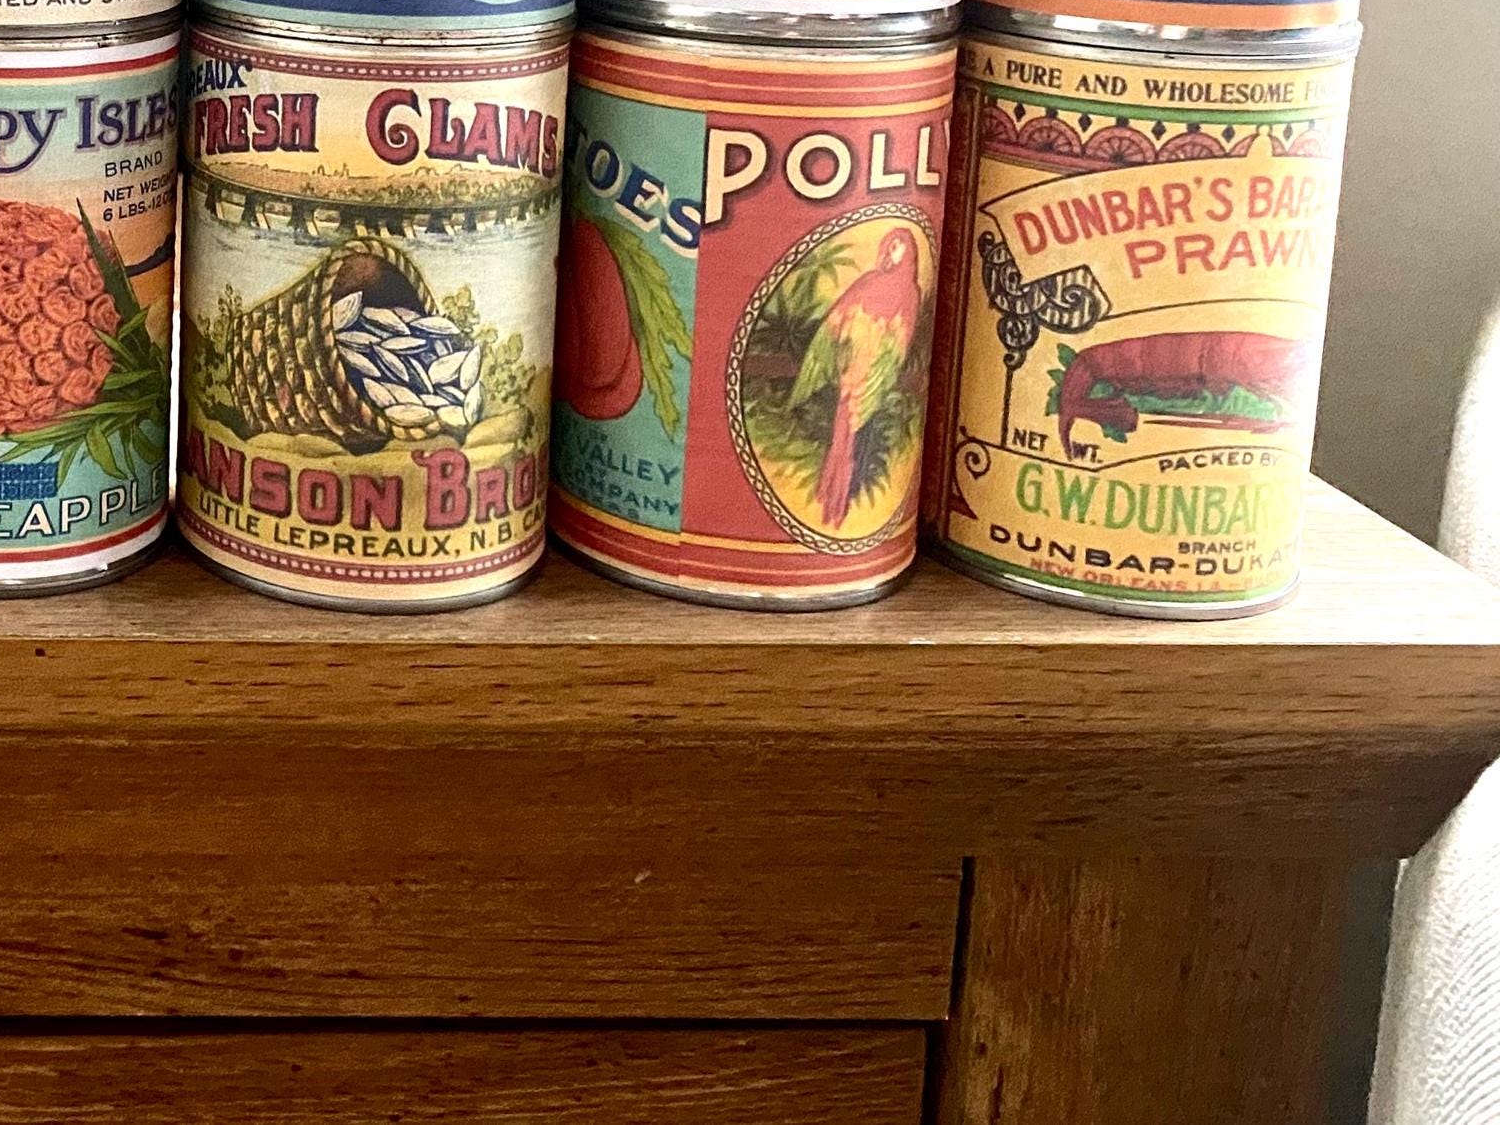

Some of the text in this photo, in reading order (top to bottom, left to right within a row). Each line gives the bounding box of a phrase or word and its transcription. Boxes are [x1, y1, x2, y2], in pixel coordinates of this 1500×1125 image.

[983, 57, 994, 76] A
[1006, 60, 1063, 89] PURE
[1075, 74, 1128, 97] AND
[1144, 78, 1295, 104] WHOLESOME
[194, 88, 560, 178] FRESH CLAMS
[105, 151, 163, 177] BRAND
[104, 185, 134, 203] NET
[103, 208, 113, 221] 6
[1013, 174, 1324, 256] DUNBAR'S BAR
[1012, 428, 1103, 464] NET WT.
[1159, 451, 1281, 473] PACKED BY
[200, 492, 260, 538] LITTLE
[274, 525, 461, 559] LEPREAUX,
[1178, 539, 1256, 556] BRANCH
[1030, 557, 1076, 577] NEW
